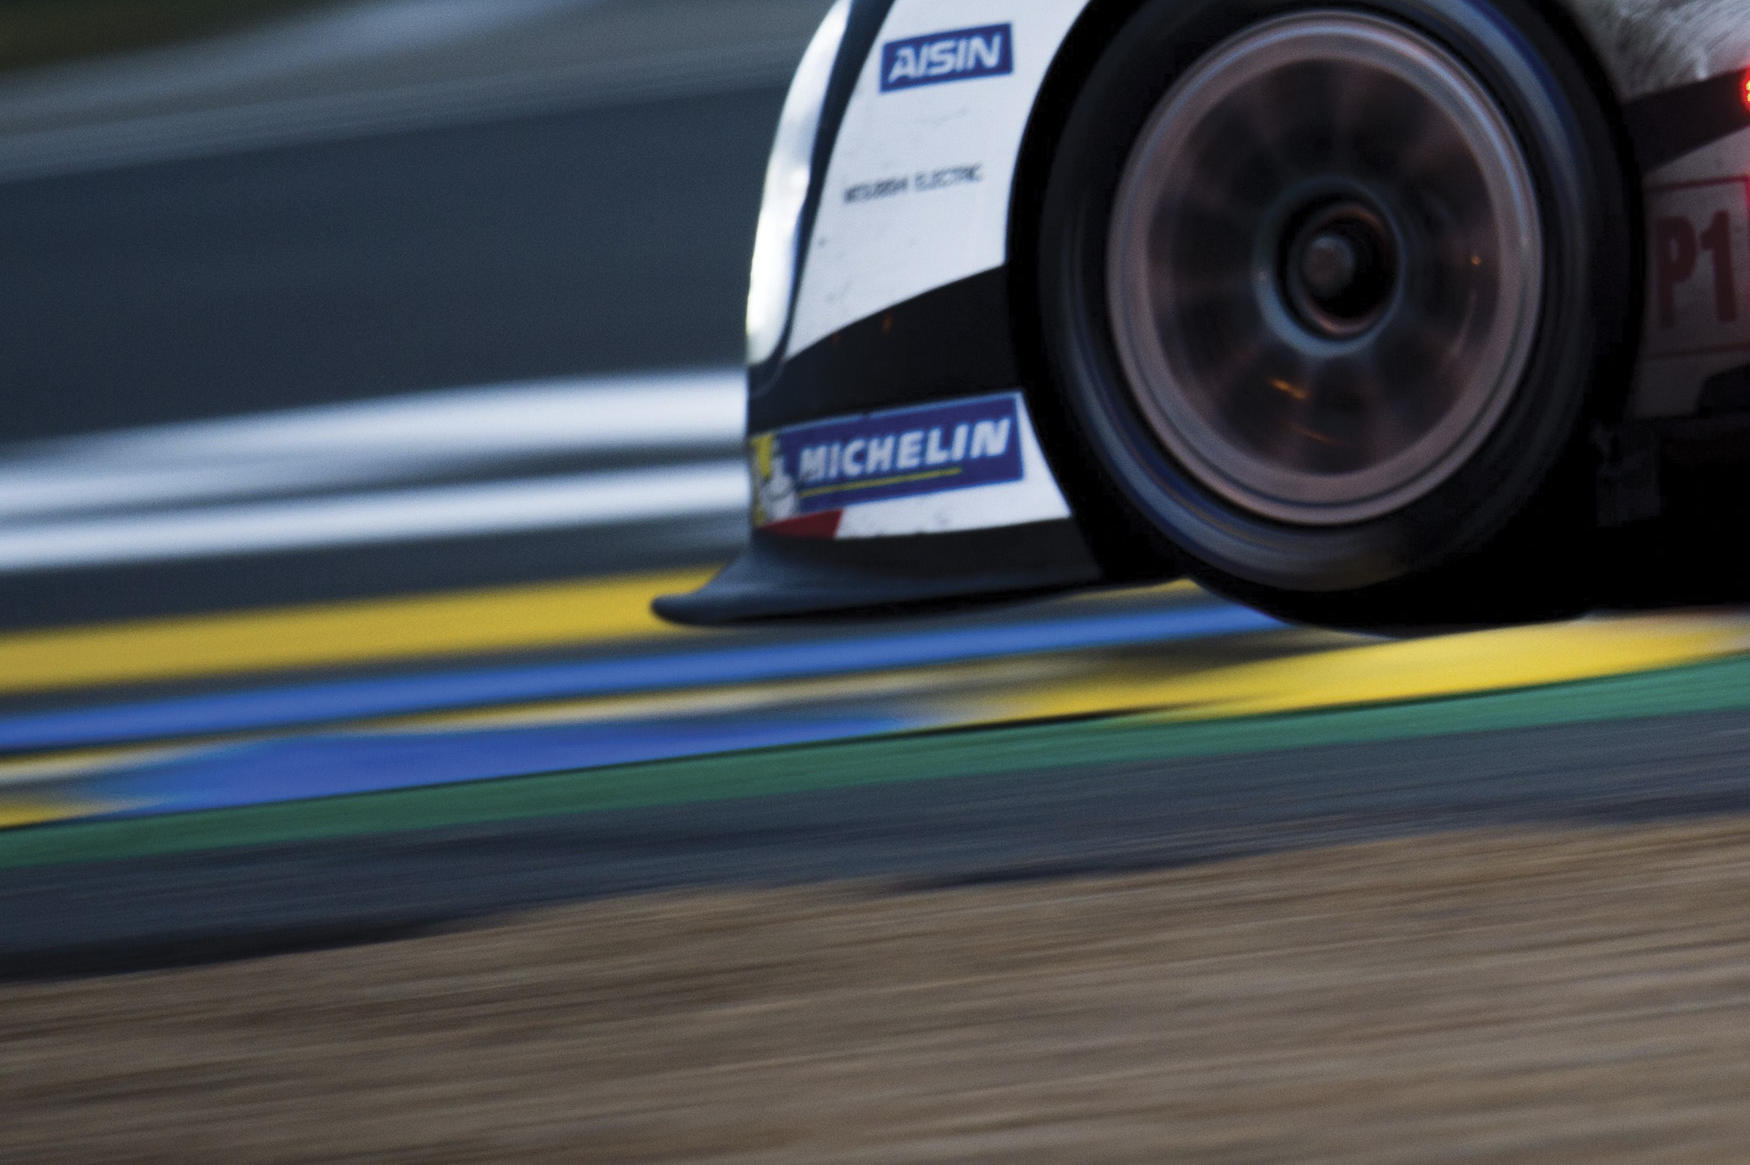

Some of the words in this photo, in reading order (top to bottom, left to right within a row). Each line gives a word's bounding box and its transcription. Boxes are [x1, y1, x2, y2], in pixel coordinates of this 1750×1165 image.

[889, 34, 1005, 83] AISIN
[1657, 207, 1739, 329] P1
[799, 418, 1011, 481] MICHELIN
